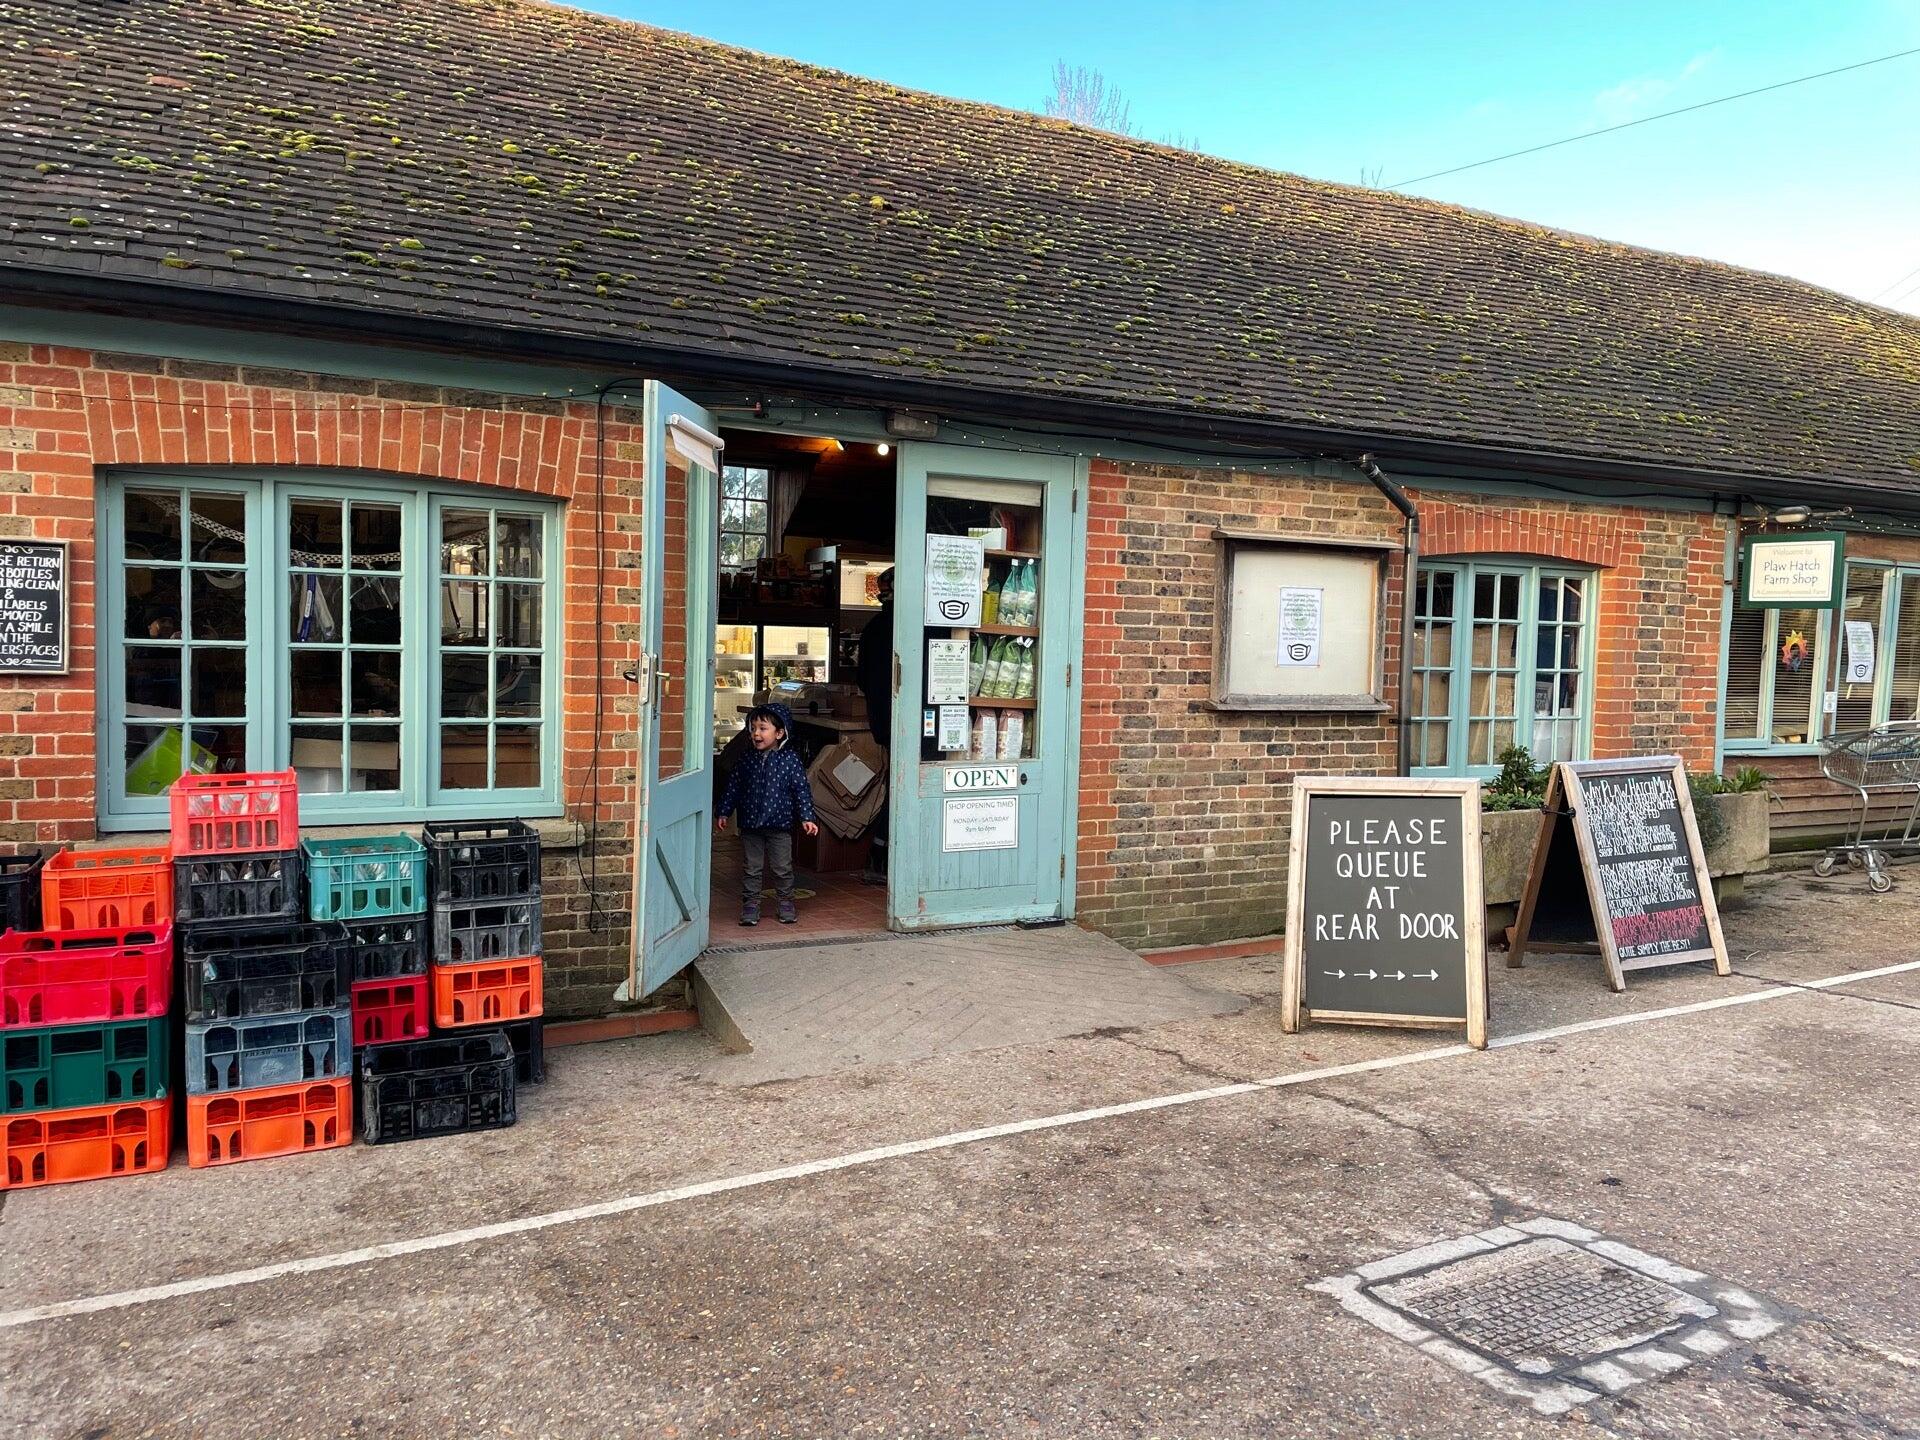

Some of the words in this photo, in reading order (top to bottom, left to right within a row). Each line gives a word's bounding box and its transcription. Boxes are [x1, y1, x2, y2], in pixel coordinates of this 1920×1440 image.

[17, 556, 60, 568] RETURN
[1764, 560, 1787, 572] Plaw
[1790, 558, 1820, 572] Hatch
[6, 567, 53, 580] BOTTLES
[1764, 574, 1790, 584] Farm
[1792, 572, 1818, 587] Shop
[24, 580, 60, 590] CLEAN
[4, 588, 15, 600] &
[5, 600, 47, 610] LABELS
[5, 622, 15, 632] A
[18, 622, 53, 633] SMILE
[10, 633, 34, 644] THE
[25, 644, 59, 656] FACES
[954, 769, 1010, 788] OPEN
[1330, 819, 1447, 845] PLEASE
[1336, 851, 1427, 878] QUEUE
[1366, 886, 1400, 910] AT
[1315, 914, 1380, 941] REAR
[1400, 912, 1459, 940] DOOR
